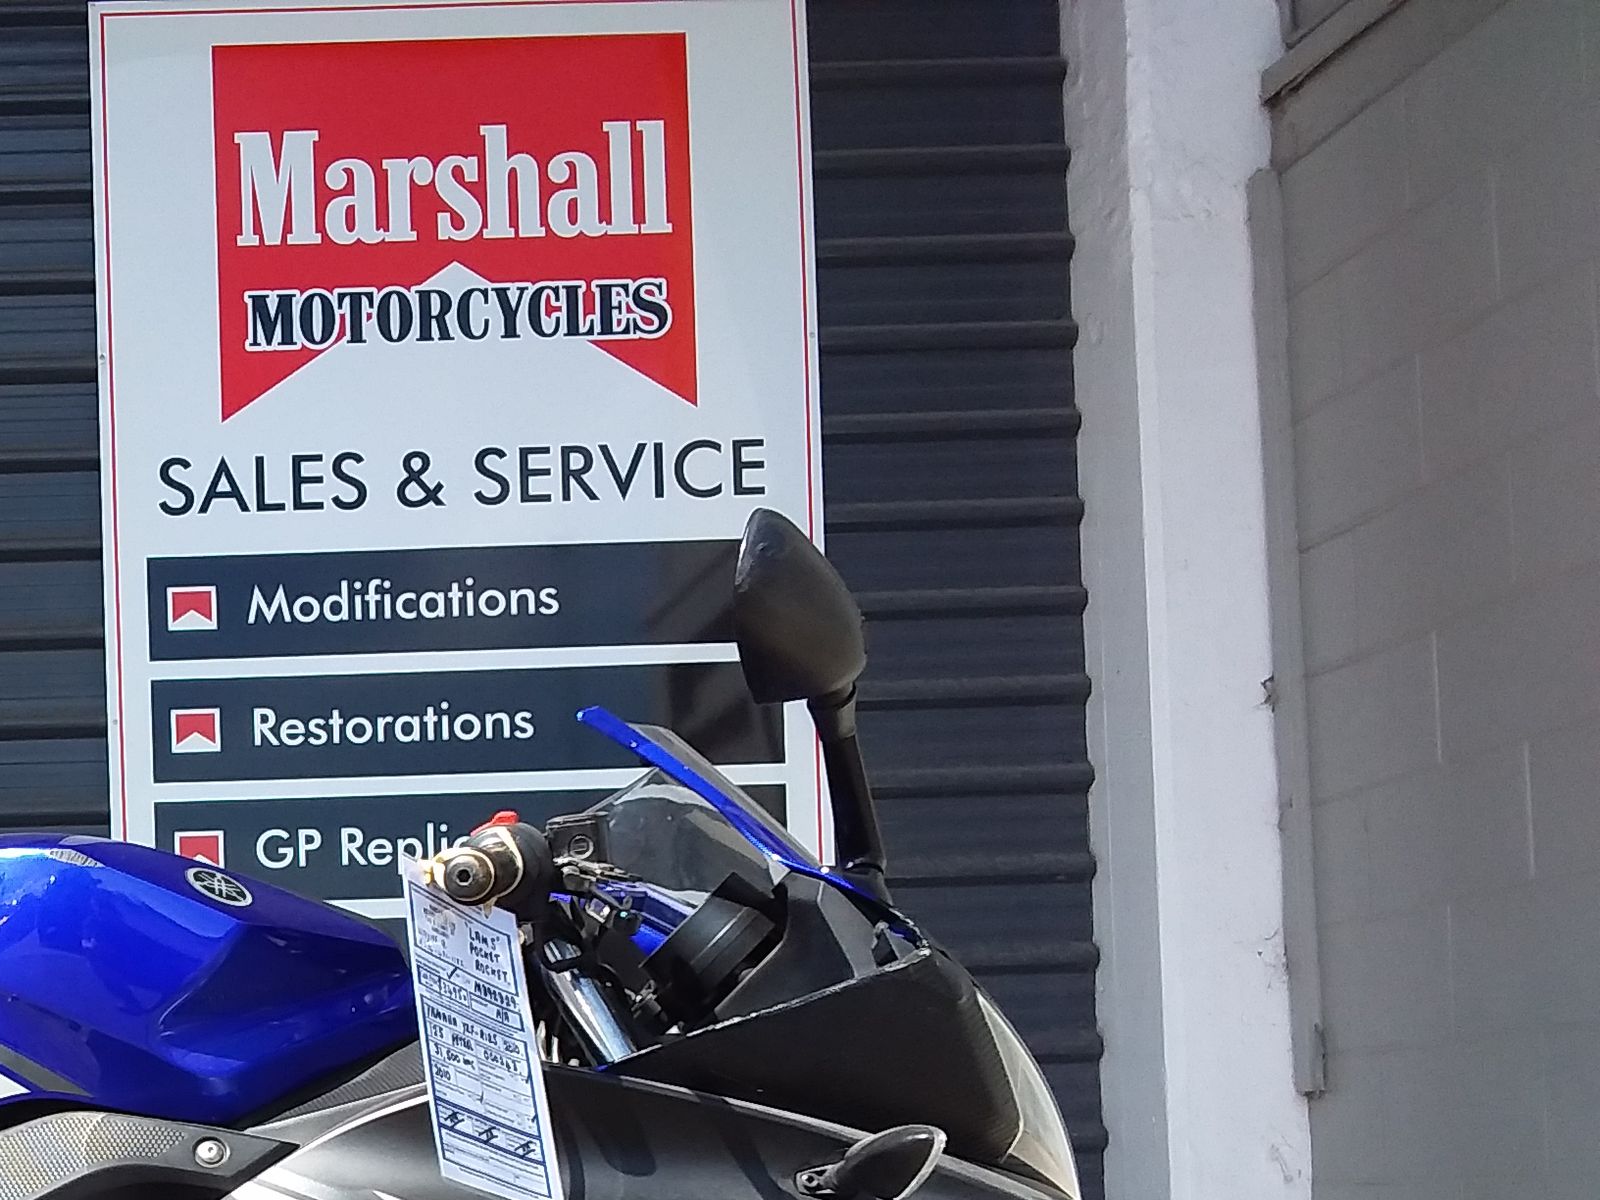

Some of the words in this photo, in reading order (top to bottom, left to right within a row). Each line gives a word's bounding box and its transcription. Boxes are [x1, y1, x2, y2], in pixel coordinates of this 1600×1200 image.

[233, 119, 673, 247] Marshall
[246, 279, 672, 350] MOTORCYCLES
[158, 450, 368, 516] SALES
[396, 449, 445, 507] &
[474, 437, 767, 505] SERVICE
[247, 577, 560, 625] Modifications
[252, 701, 535, 748] Restorations
[255, 828, 322, 870] GP
